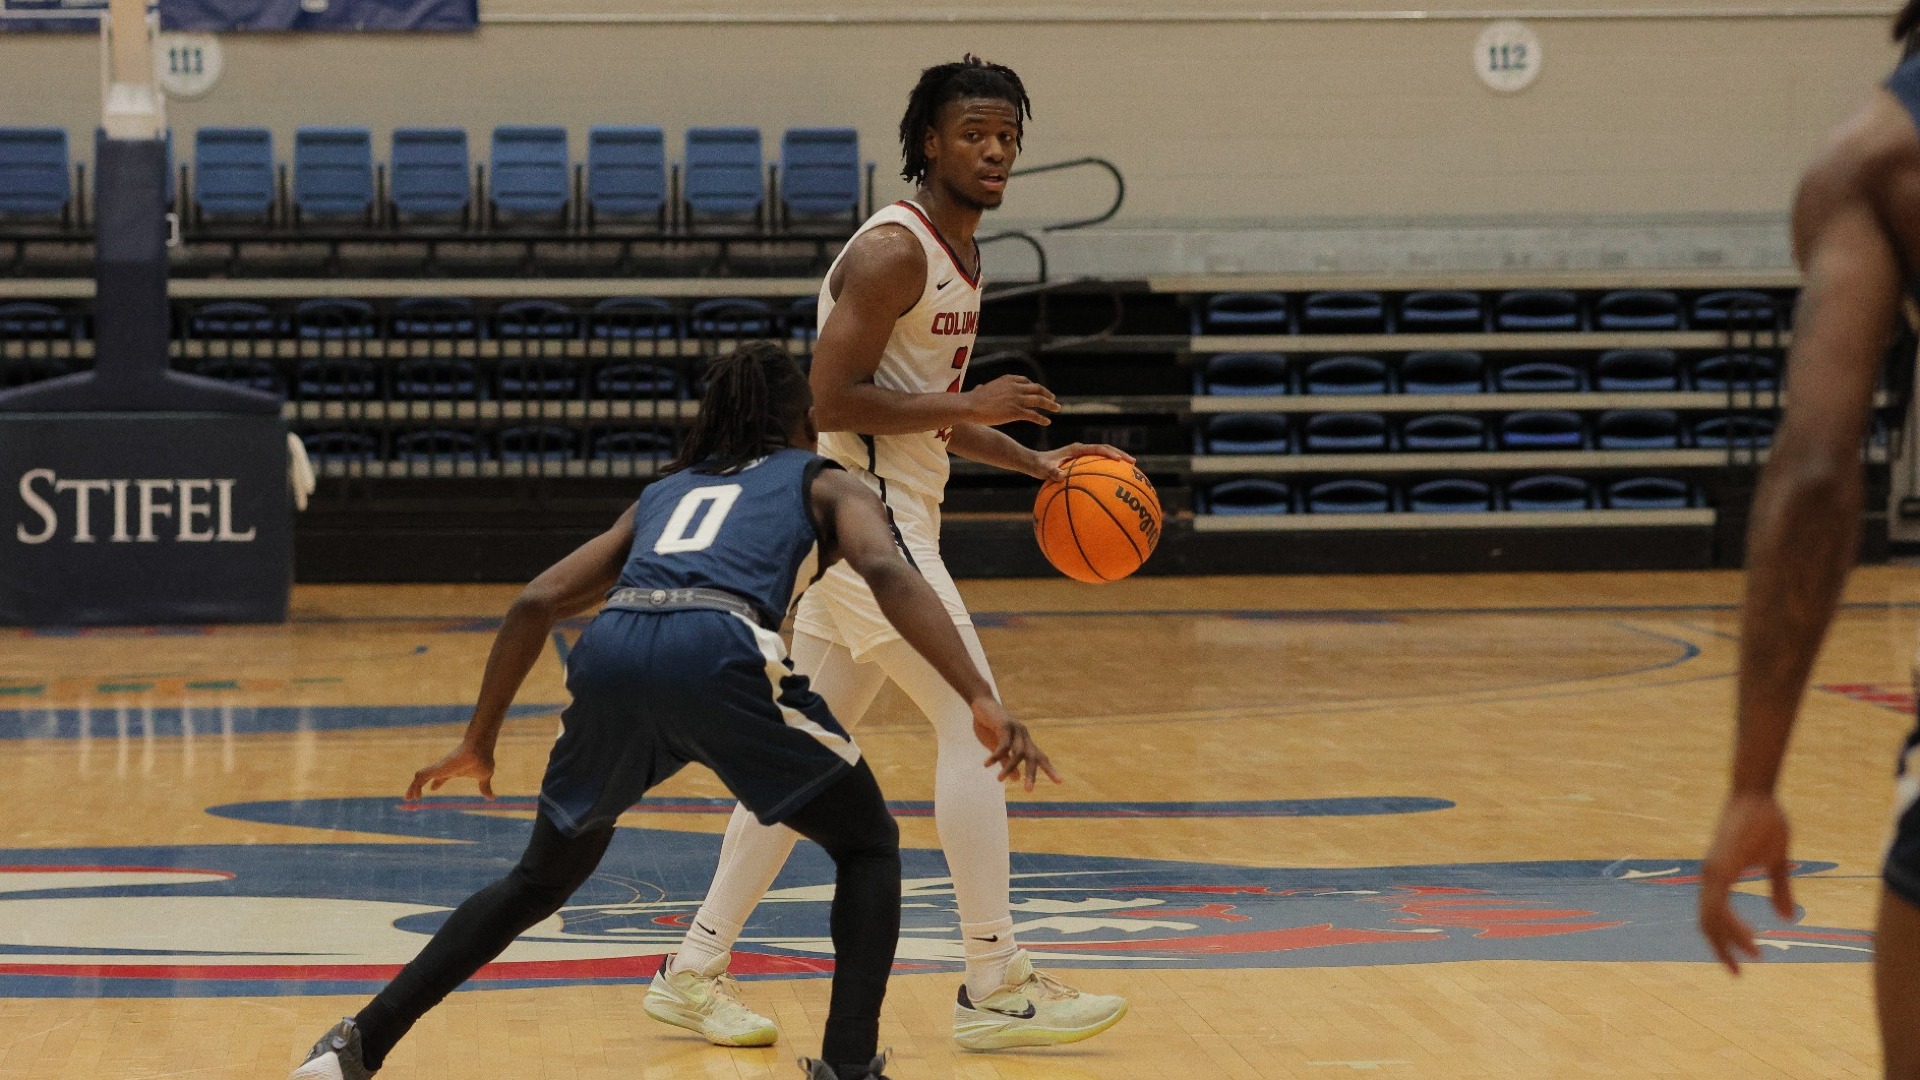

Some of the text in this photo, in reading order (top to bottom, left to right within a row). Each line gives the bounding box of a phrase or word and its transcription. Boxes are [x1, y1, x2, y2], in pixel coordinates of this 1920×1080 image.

[169, 46, 204, 75] 111
[1489, 43, 1527, 71] 112
[931, 311, 979, 335] COLUM
[16, 467, 257, 545] STIFEL
[653, 483, 743, 556] 0
